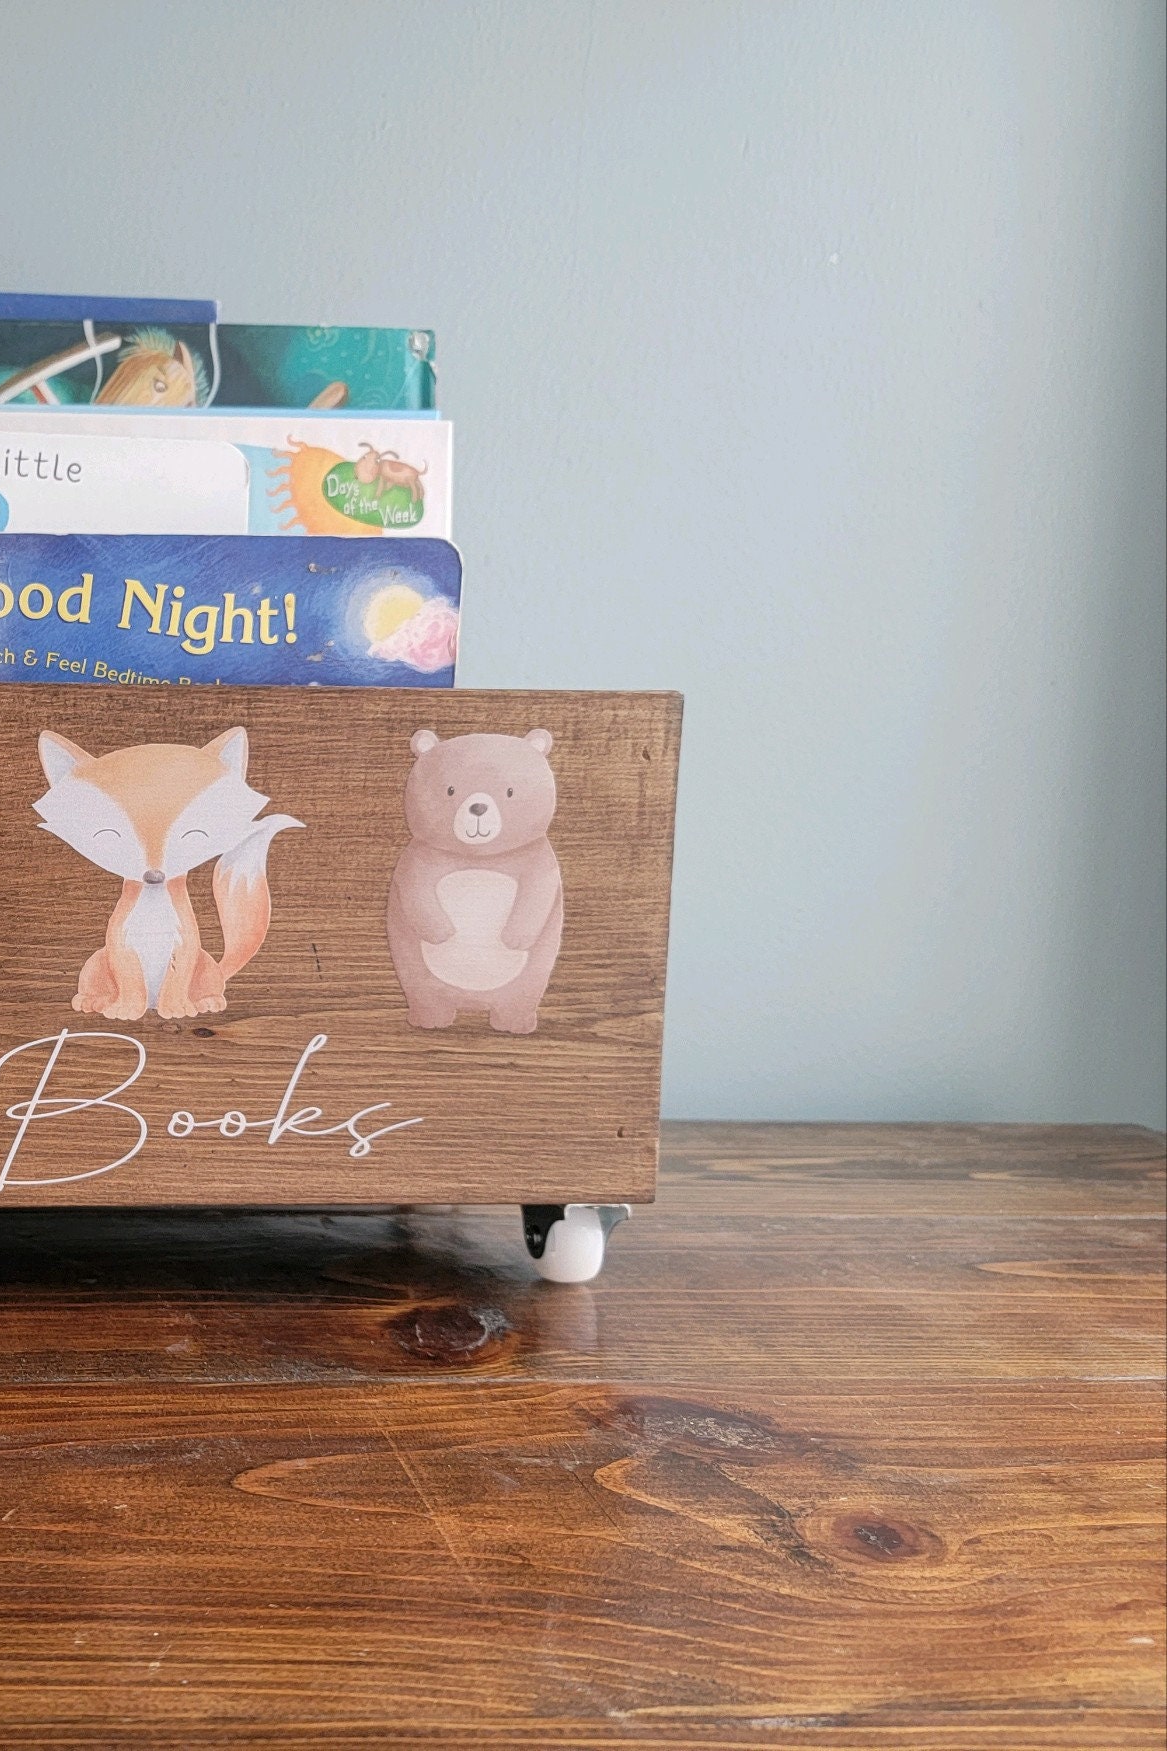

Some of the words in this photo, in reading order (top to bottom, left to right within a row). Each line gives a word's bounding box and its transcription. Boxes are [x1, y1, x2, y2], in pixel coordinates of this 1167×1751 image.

[326, 474, 361, 499] Days
[343, 497, 357, 516] of
[359, 499, 379, 515] the
[379, 502, 418, 528] Week
[117, 578, 298, 655] Night!
[23, 649, 38, 666] &
[45, 651, 88, 675] Feel
